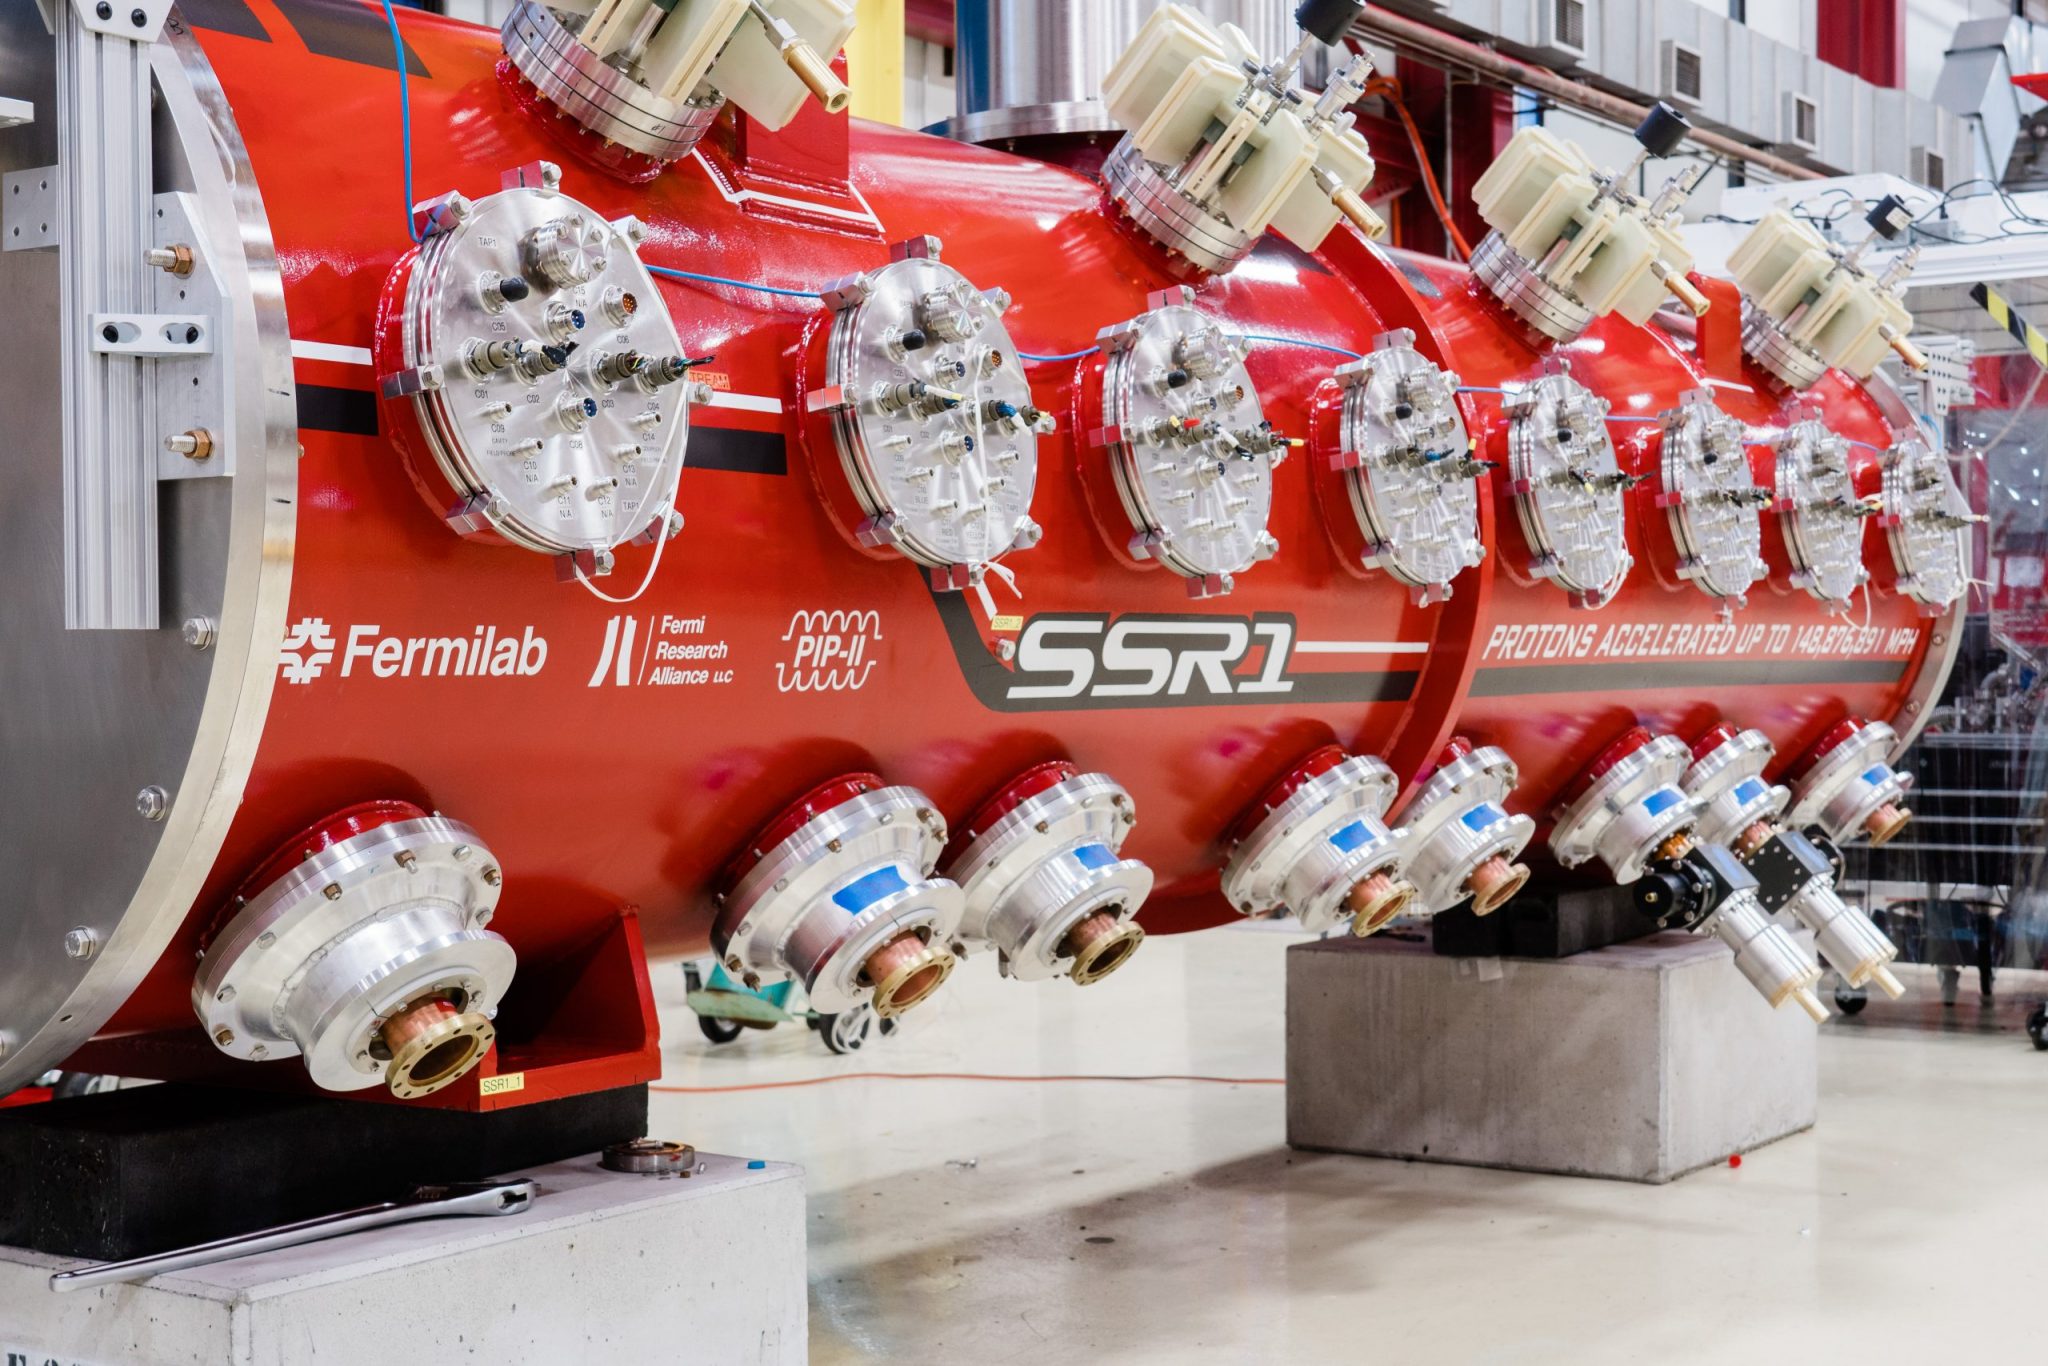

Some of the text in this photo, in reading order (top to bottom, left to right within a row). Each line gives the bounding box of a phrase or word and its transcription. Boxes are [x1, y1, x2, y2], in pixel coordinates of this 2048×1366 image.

[478, 236, 497, 247] TAP1
[491, 321, 506, 331] C05
[474, 389, 489, 399] C01
[526, 394, 540, 404] C02
[601, 399, 615, 409] C03
[490, 423, 505, 433] C09
[642, 432, 656, 442] C14
[523, 460, 538, 471] C10
[622, 464, 636, 474] C13
[525, 473, 538, 483] N/A
[622, 501, 640, 511] TAP1
[559, 509, 573, 519] N/A
[660, 614, 705, 635] Fermi
[1481, 623, 1921, 660] PROTONS ACCELERATED UP TO 148,876,891 MPH
[340, 624, 548, 678] Fermilab
[655, 640, 728, 661] Research
[794, 634, 867, 669] PIP-II
[1006, 620, 1294, 699] SSR1
[648, 666, 708, 686] Alliance
